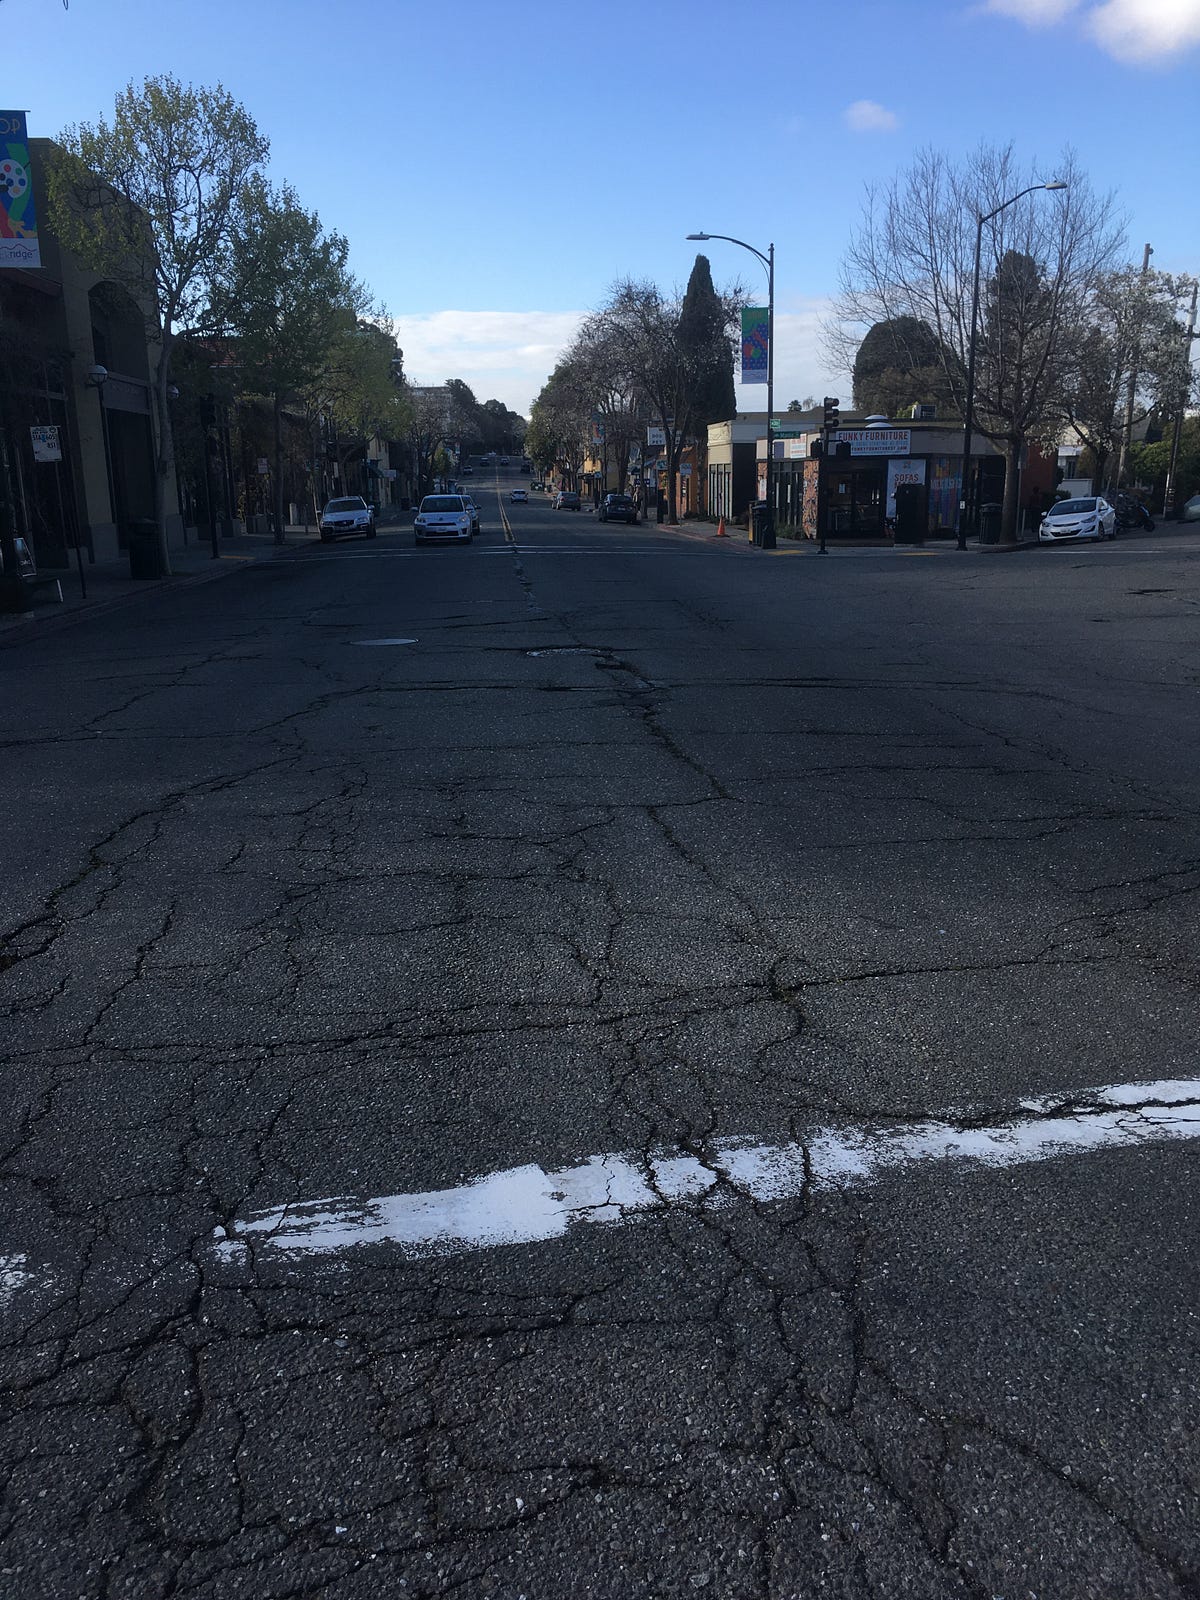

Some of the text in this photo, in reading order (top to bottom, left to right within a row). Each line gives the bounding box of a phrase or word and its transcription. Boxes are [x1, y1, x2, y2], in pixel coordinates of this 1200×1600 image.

[839, 432, 908, 441] FUNKY FURNITURE
[895, 473, 919, 482] SOFAS
